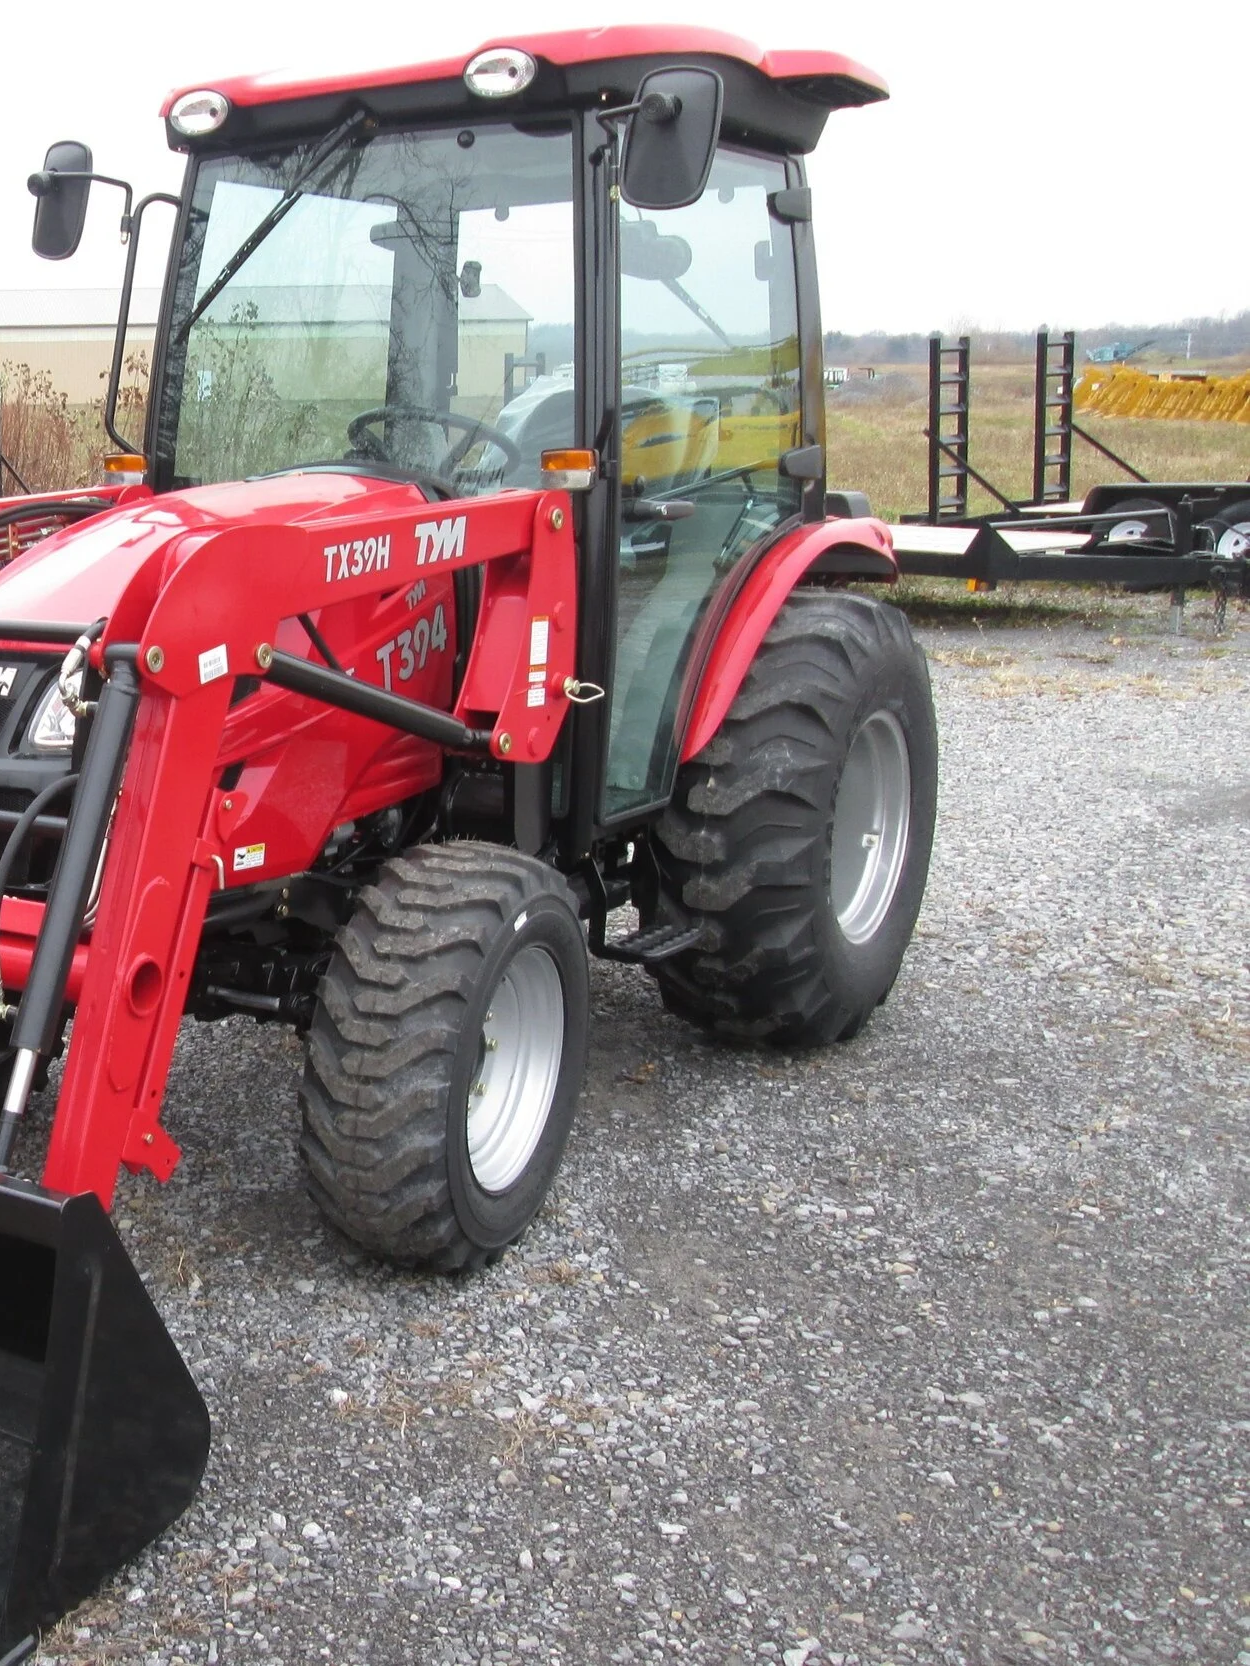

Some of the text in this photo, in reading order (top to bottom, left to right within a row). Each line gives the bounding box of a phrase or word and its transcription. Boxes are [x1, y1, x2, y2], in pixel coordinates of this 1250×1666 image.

[323, 516, 467, 583] TX39H TYM
[405, 579, 426, 611] TYM
[376, 604, 447, 692] T394
